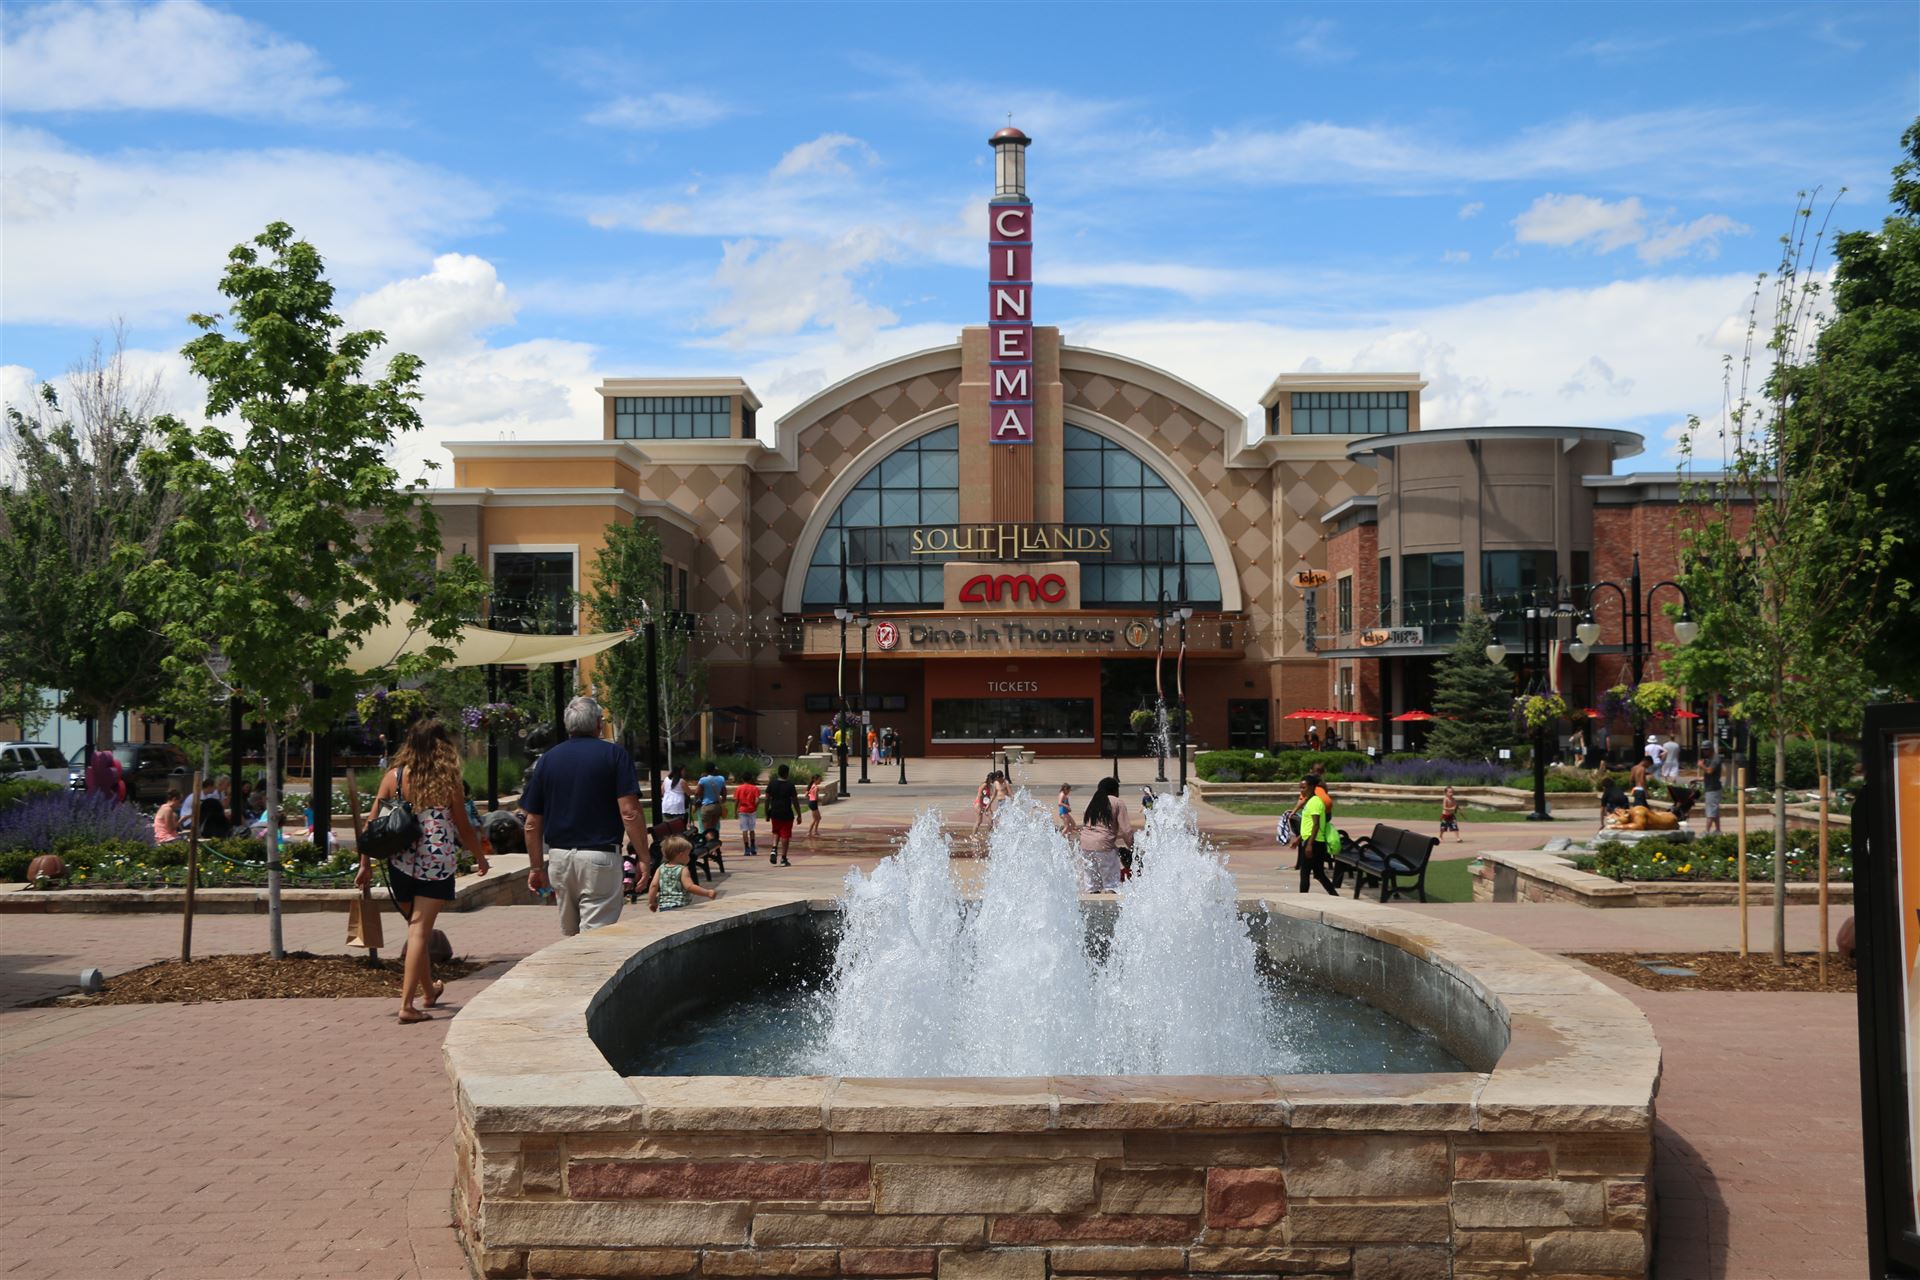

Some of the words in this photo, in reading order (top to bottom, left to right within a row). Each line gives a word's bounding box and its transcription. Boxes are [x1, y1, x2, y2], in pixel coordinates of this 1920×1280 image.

[995, 209, 1028, 436] CINEMA
[911, 524, 1112, 559] SOUTHLANDS
[1297, 569, 1327, 588] Tokyo
[1002, 622, 1116, 645] Theatres
[987, 681, 1038, 692] TICKETS
